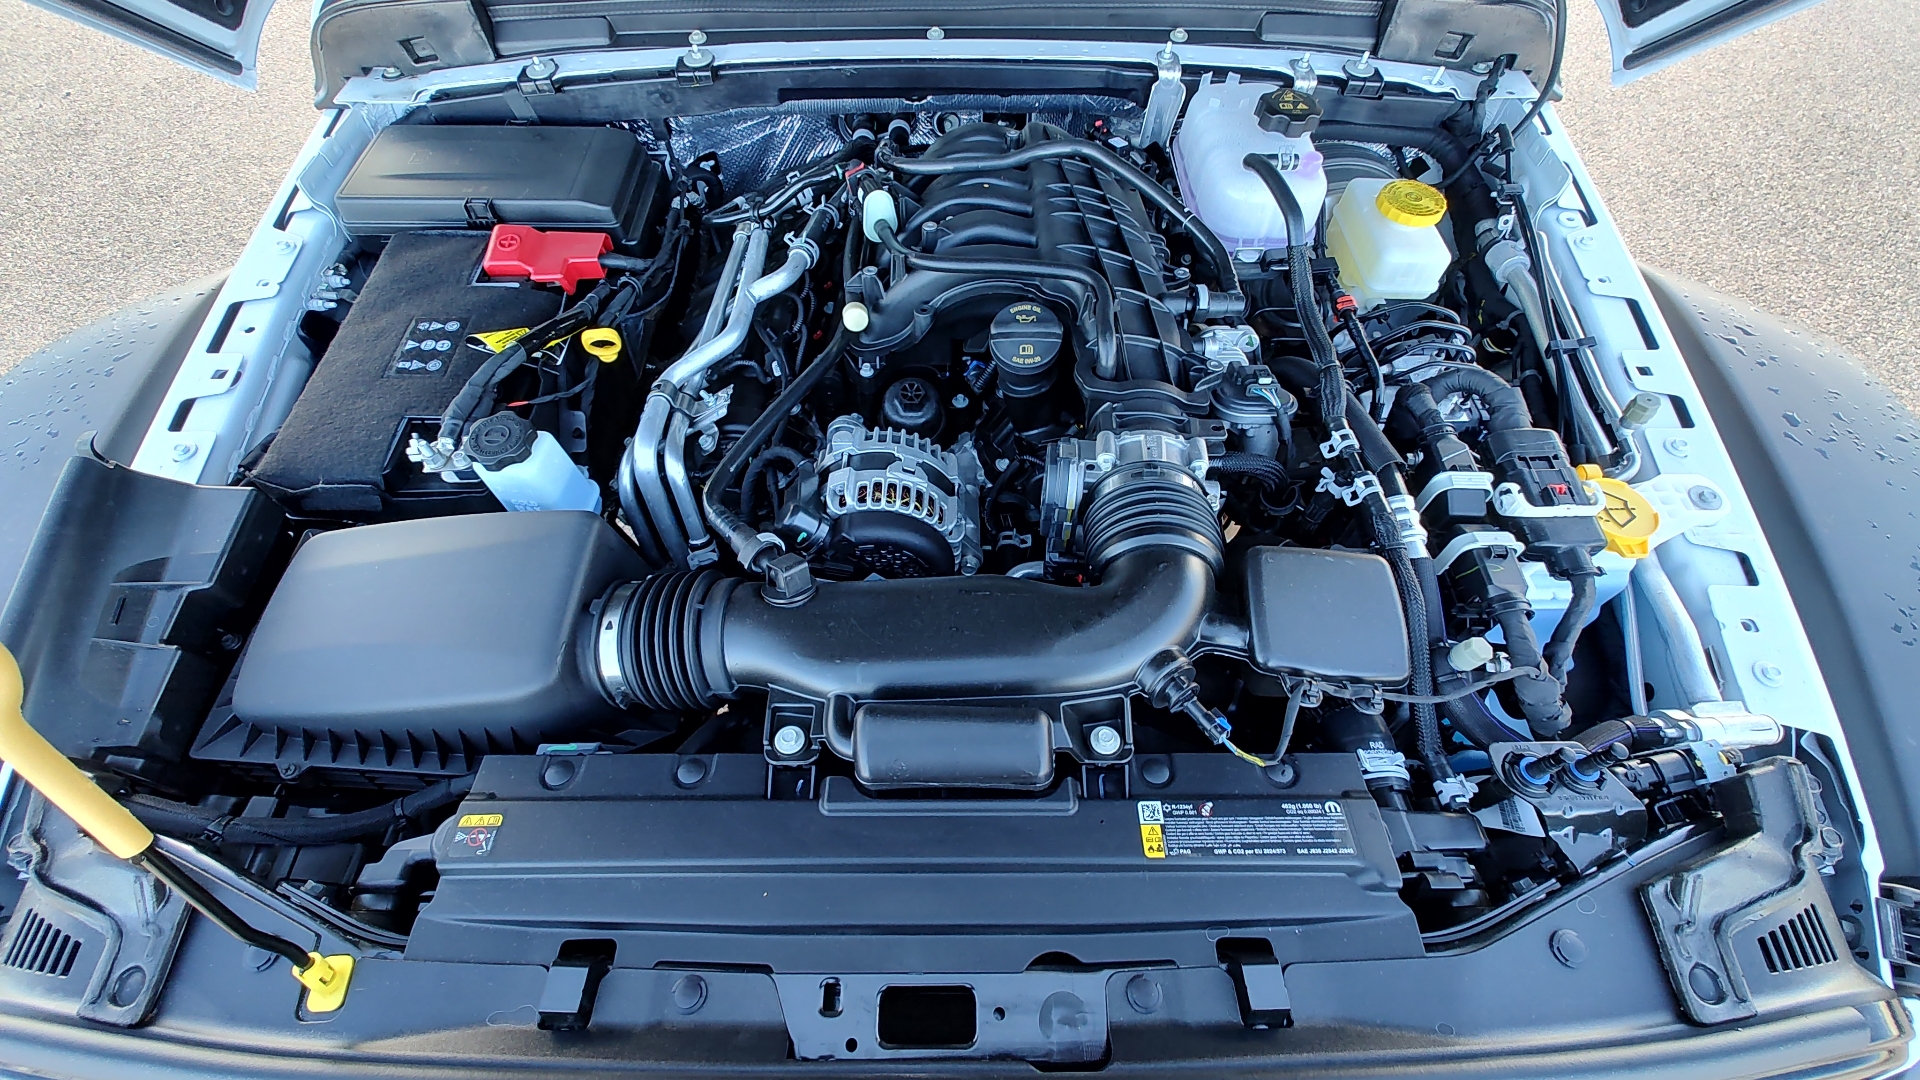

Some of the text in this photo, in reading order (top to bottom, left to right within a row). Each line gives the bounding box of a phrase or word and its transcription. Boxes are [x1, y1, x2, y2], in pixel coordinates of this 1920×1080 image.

[1010, 305, 1041, 314] ENGINE OIL
[1012, 356, 1041, 364] SAE 0W-20
[1369, 741, 1385, 749] RAD
